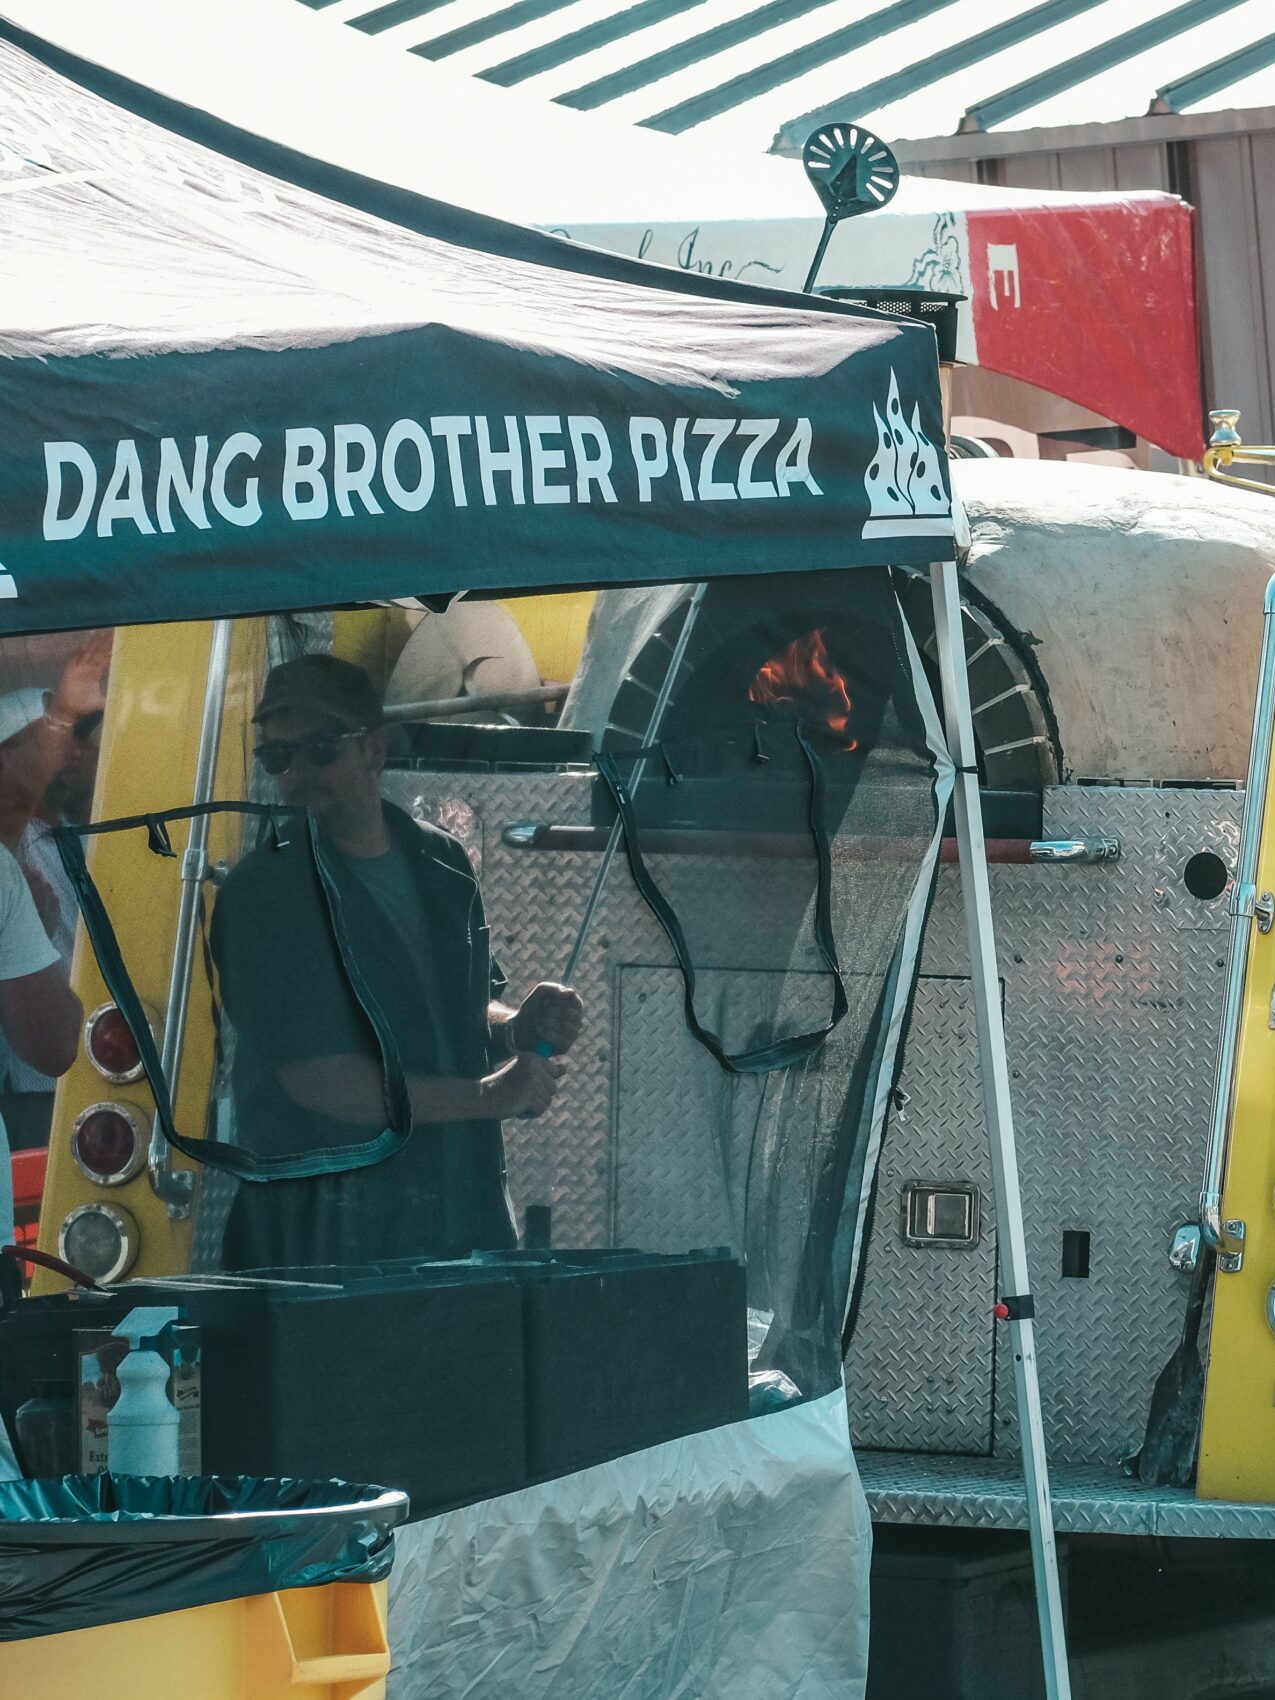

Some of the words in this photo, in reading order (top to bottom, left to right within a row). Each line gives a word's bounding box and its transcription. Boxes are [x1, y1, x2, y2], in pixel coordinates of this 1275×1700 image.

[43, 432, 263, 541] DANG
[282, 415, 619, 521] BROTHER
[628, 415, 824, 504] PIZZA
